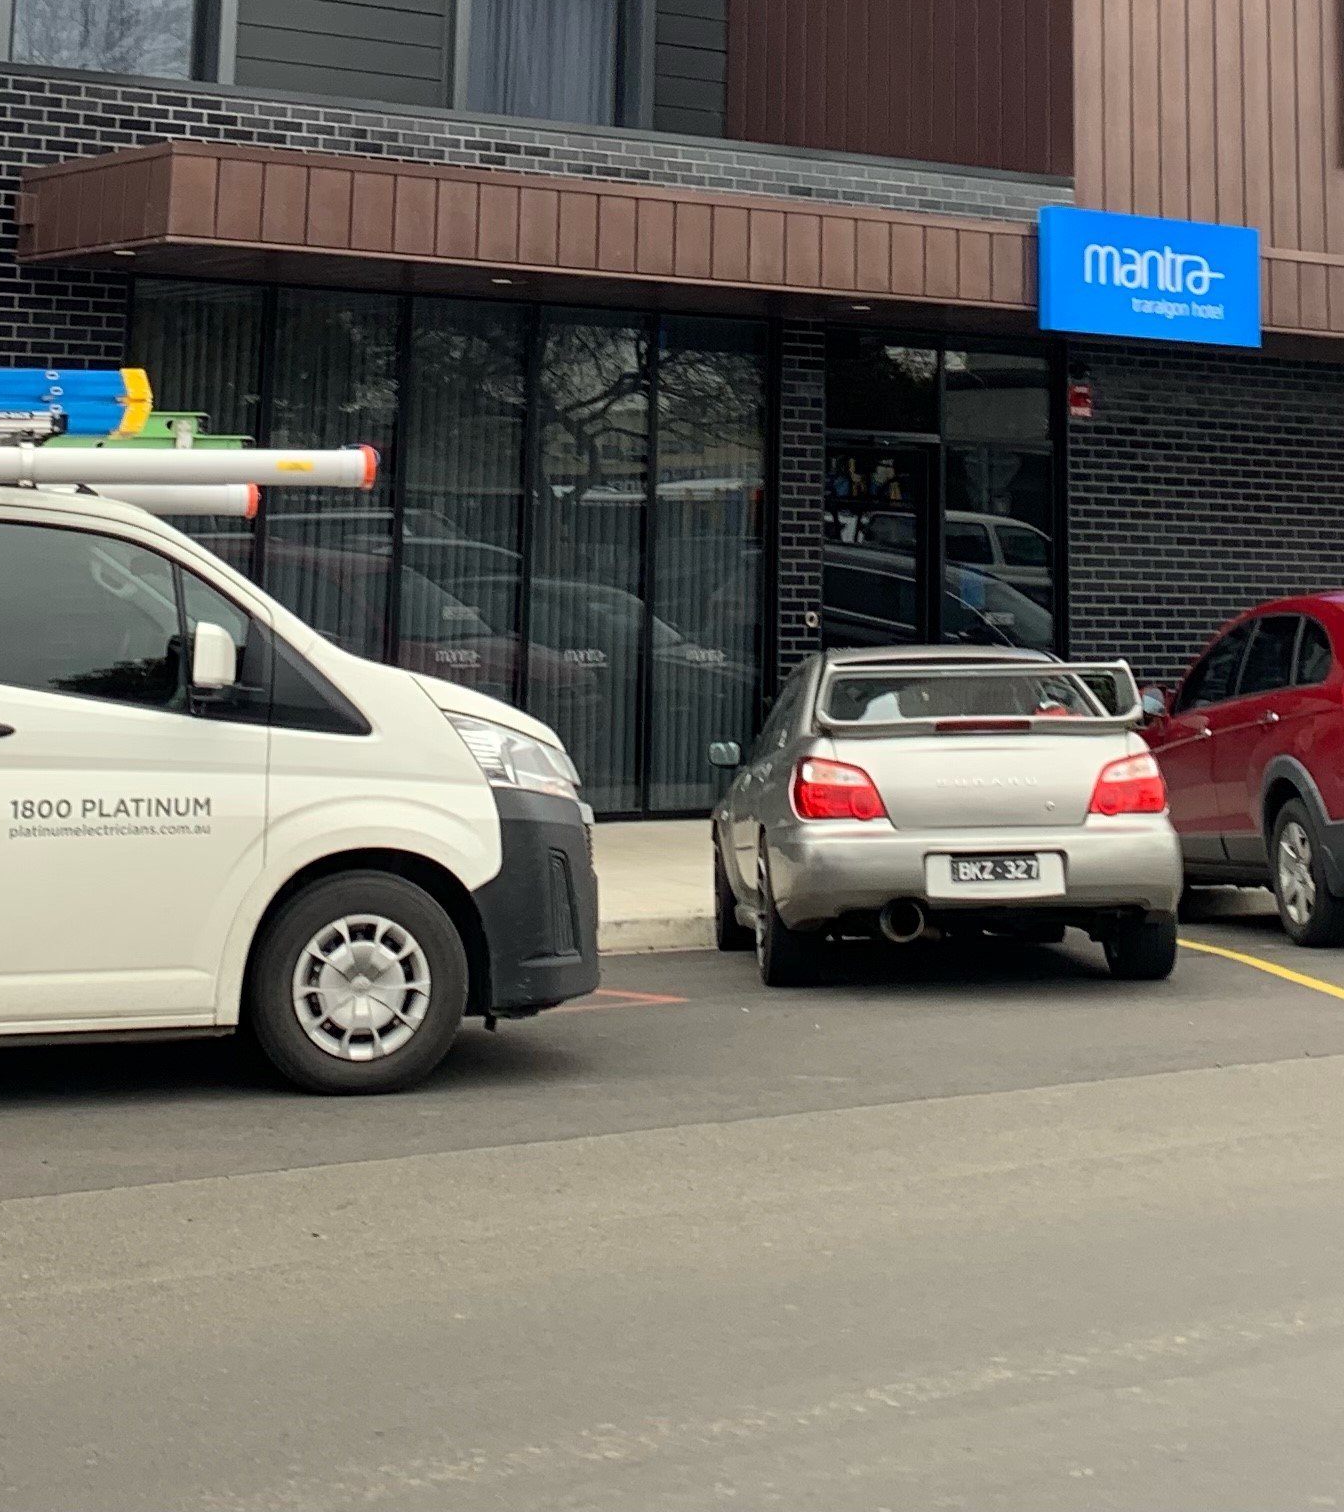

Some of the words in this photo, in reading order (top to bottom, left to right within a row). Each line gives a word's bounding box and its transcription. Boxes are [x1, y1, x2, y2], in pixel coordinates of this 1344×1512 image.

[1083, 243, 1226, 296] mantra
[1191, 300, 1225, 320] hotel
[10, 799, 72, 819] 1800
[81, 797, 212, 818] PLATINUM
[9, 824, 211, 839] platinumelectricians.com.au
